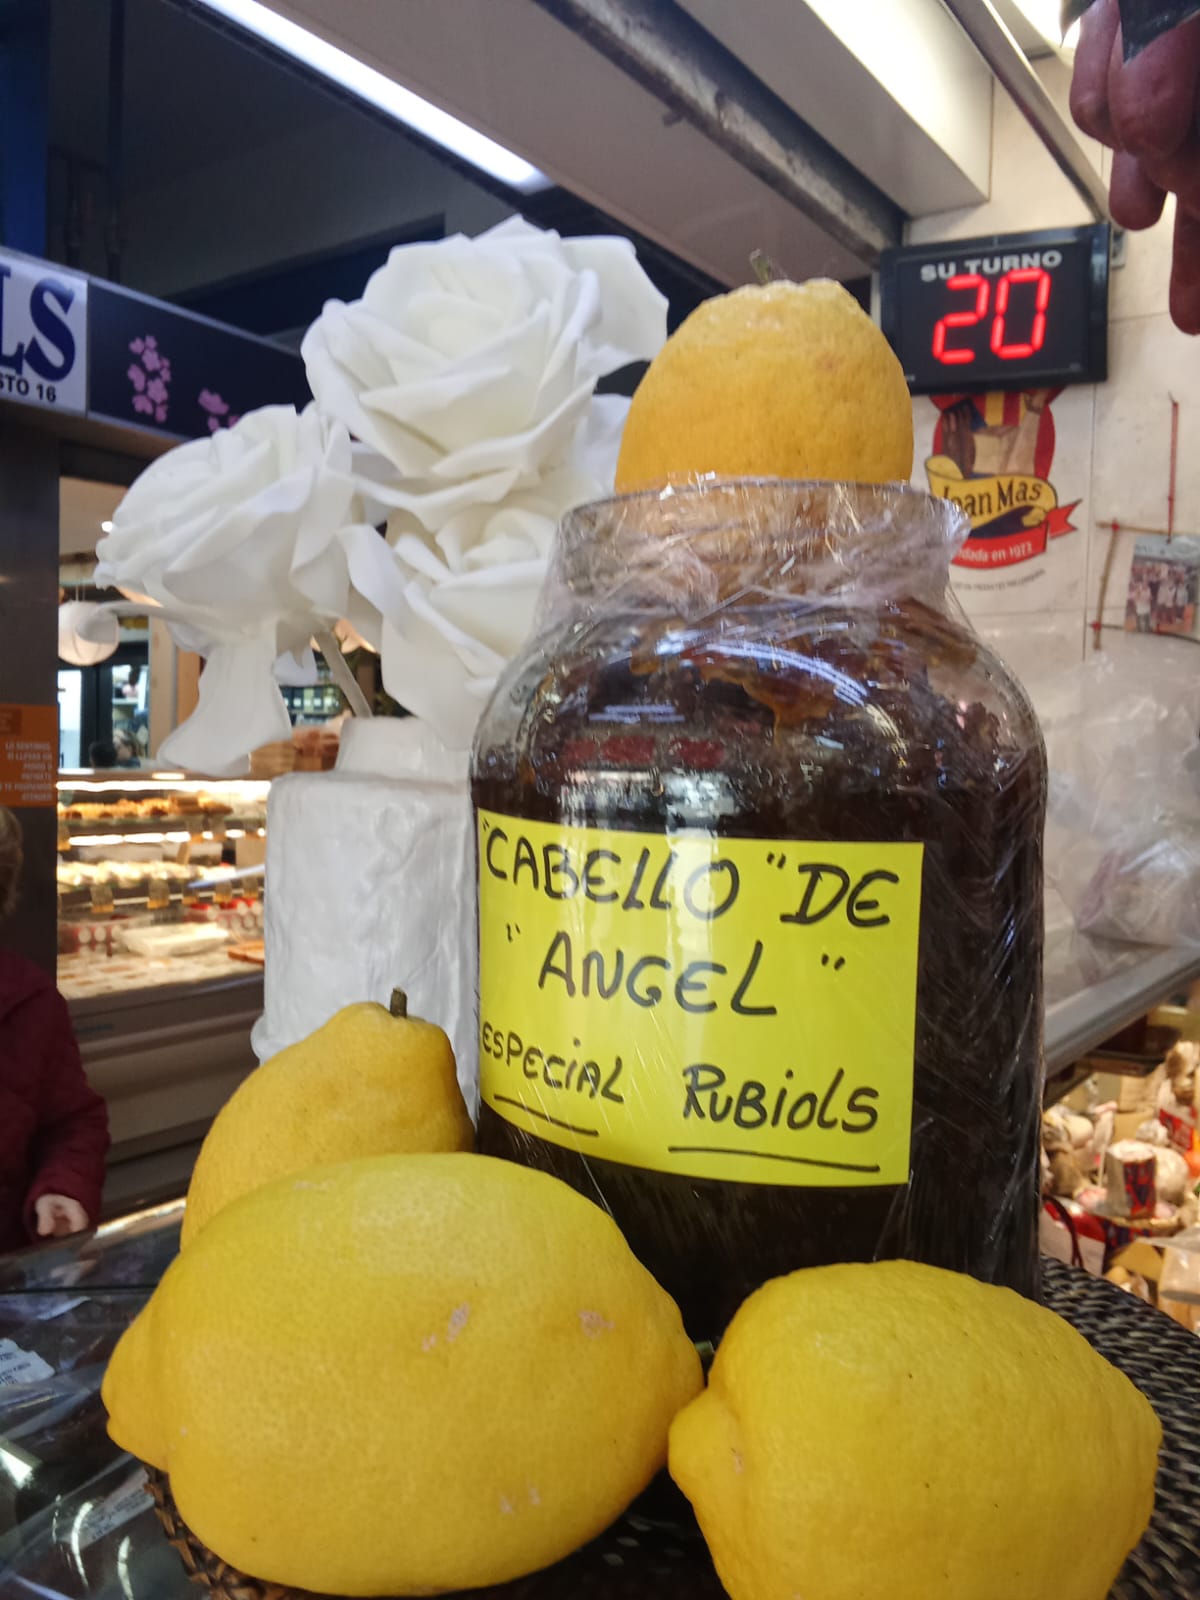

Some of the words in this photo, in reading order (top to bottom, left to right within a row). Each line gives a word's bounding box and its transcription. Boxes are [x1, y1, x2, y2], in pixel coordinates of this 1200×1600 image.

[920, 264, 957, 282] SU
[964, 250, 1063, 276] TURNO
[932, 267, 1051, 365] 20
[36, 384, 56, 403] 16
[997, 478, 1042, 512] Mas
[991, 549, 1006, 562] en
